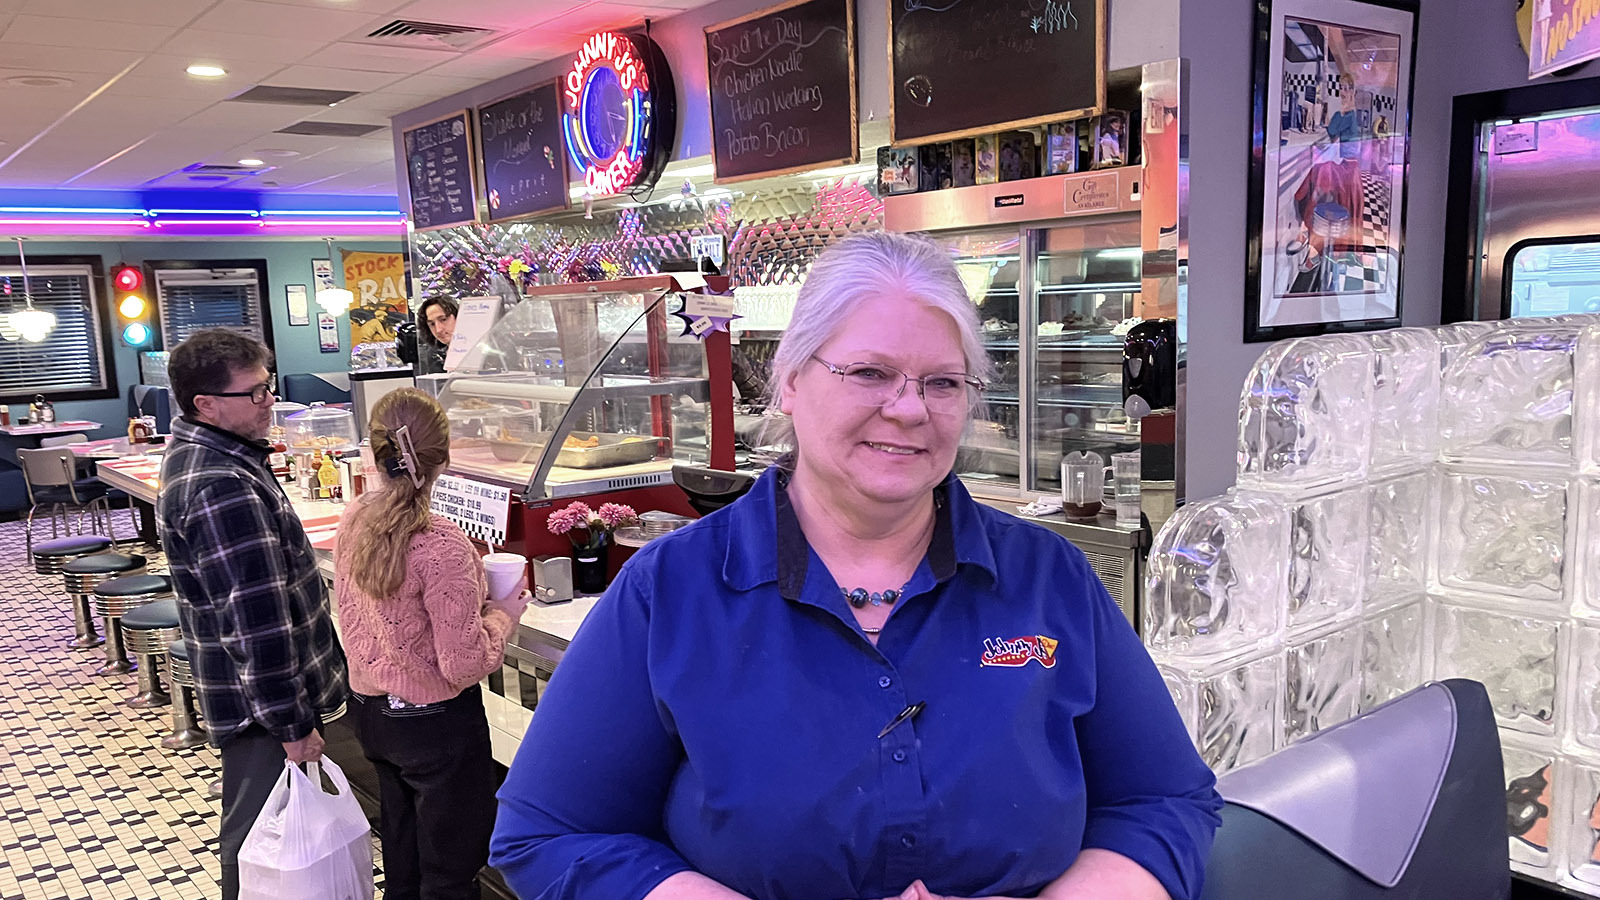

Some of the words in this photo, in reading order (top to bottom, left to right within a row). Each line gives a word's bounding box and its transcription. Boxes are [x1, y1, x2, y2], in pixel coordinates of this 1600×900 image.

[773, 17, 803, 47] Day
[565, 32, 617, 107] JOHNNY
[724, 66, 768, 98] Chicken
[759, 122, 810, 158] Bacon
[585, 151, 632, 195] DINER
[346, 255, 399, 281] STOCK
[983, 637, 1032, 659] Johnny
